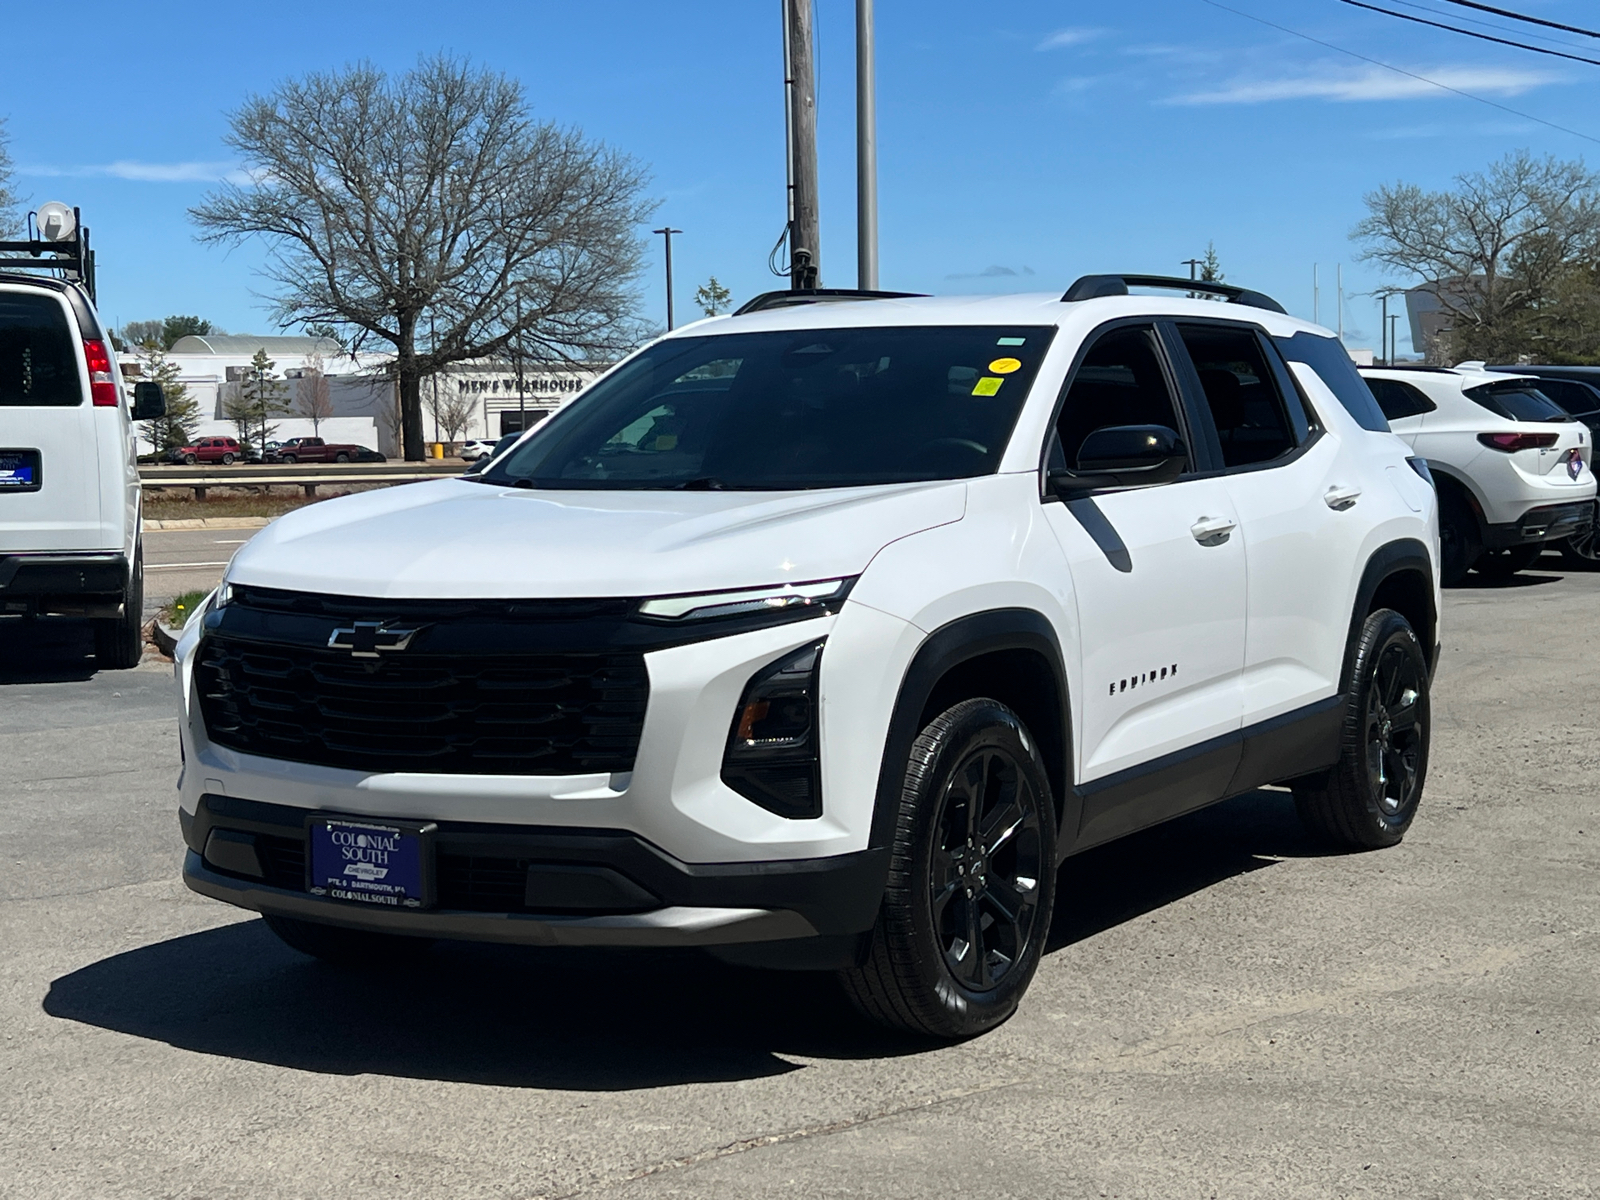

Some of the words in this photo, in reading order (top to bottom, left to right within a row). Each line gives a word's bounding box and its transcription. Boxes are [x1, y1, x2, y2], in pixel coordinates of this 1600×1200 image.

[458, 379, 500, 394] MEN'S
[502, 379, 583, 393] WEARHOUSE
[1109, 663, 1177, 696] EQUINOX
[331, 831, 399, 852] COLONIAL
[341, 847, 389, 865] SOUTH
[347, 867, 385, 876] CHEVROLET
